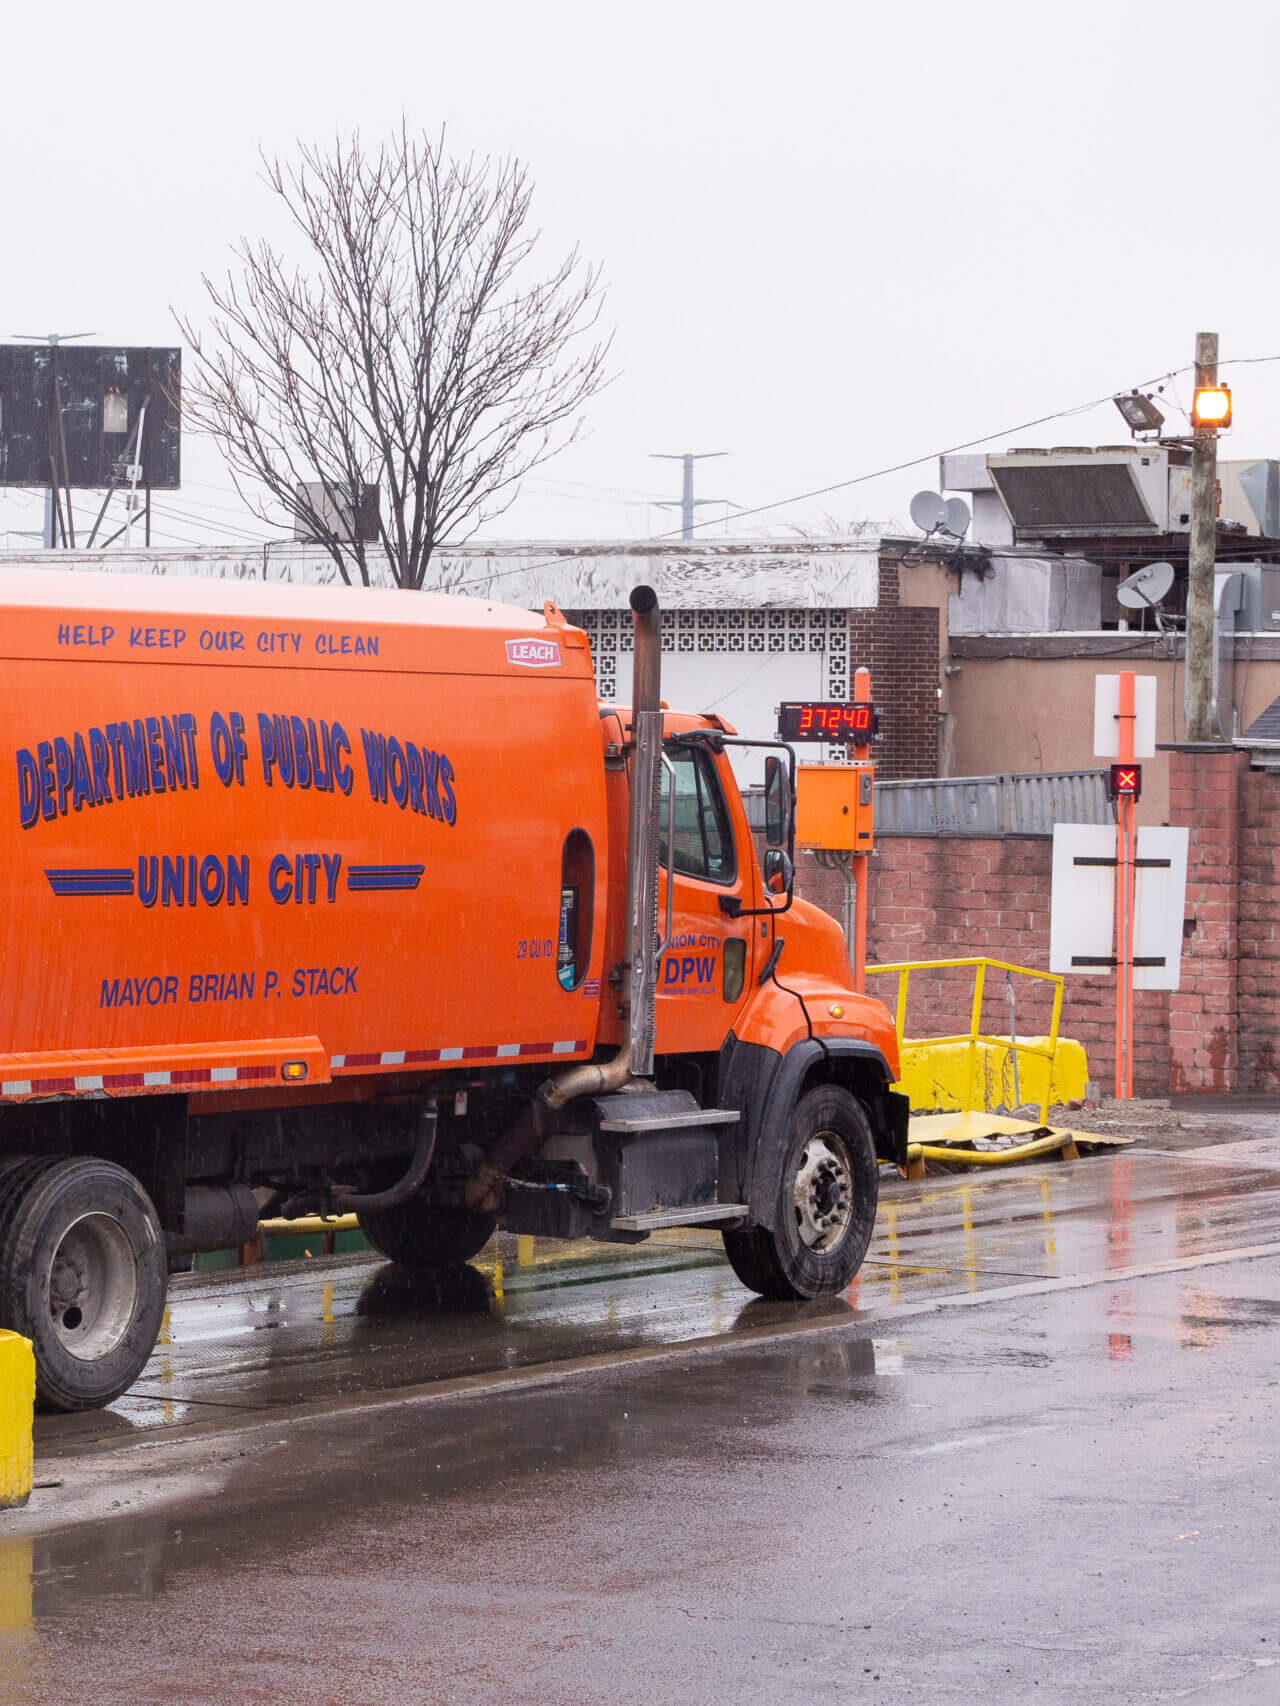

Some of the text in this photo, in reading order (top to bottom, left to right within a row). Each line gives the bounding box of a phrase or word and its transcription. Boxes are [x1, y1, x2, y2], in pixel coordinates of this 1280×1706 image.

[57, 624, 379, 655] HELP KEEP OUR CITY CLEAN
[512, 645, 555, 660] LEACH
[800, 708, 870, 729] 37240
[16, 711, 457, 831] DEPARTMENT OF PUBLIC WORKS
[138, 853, 342, 908] UNION CITY
[668, 933, 721, 952] NION CITY
[664, 956, 716, 985] DPW
[99, 966, 360, 1008] MAYOR BRIAN P. STACK
